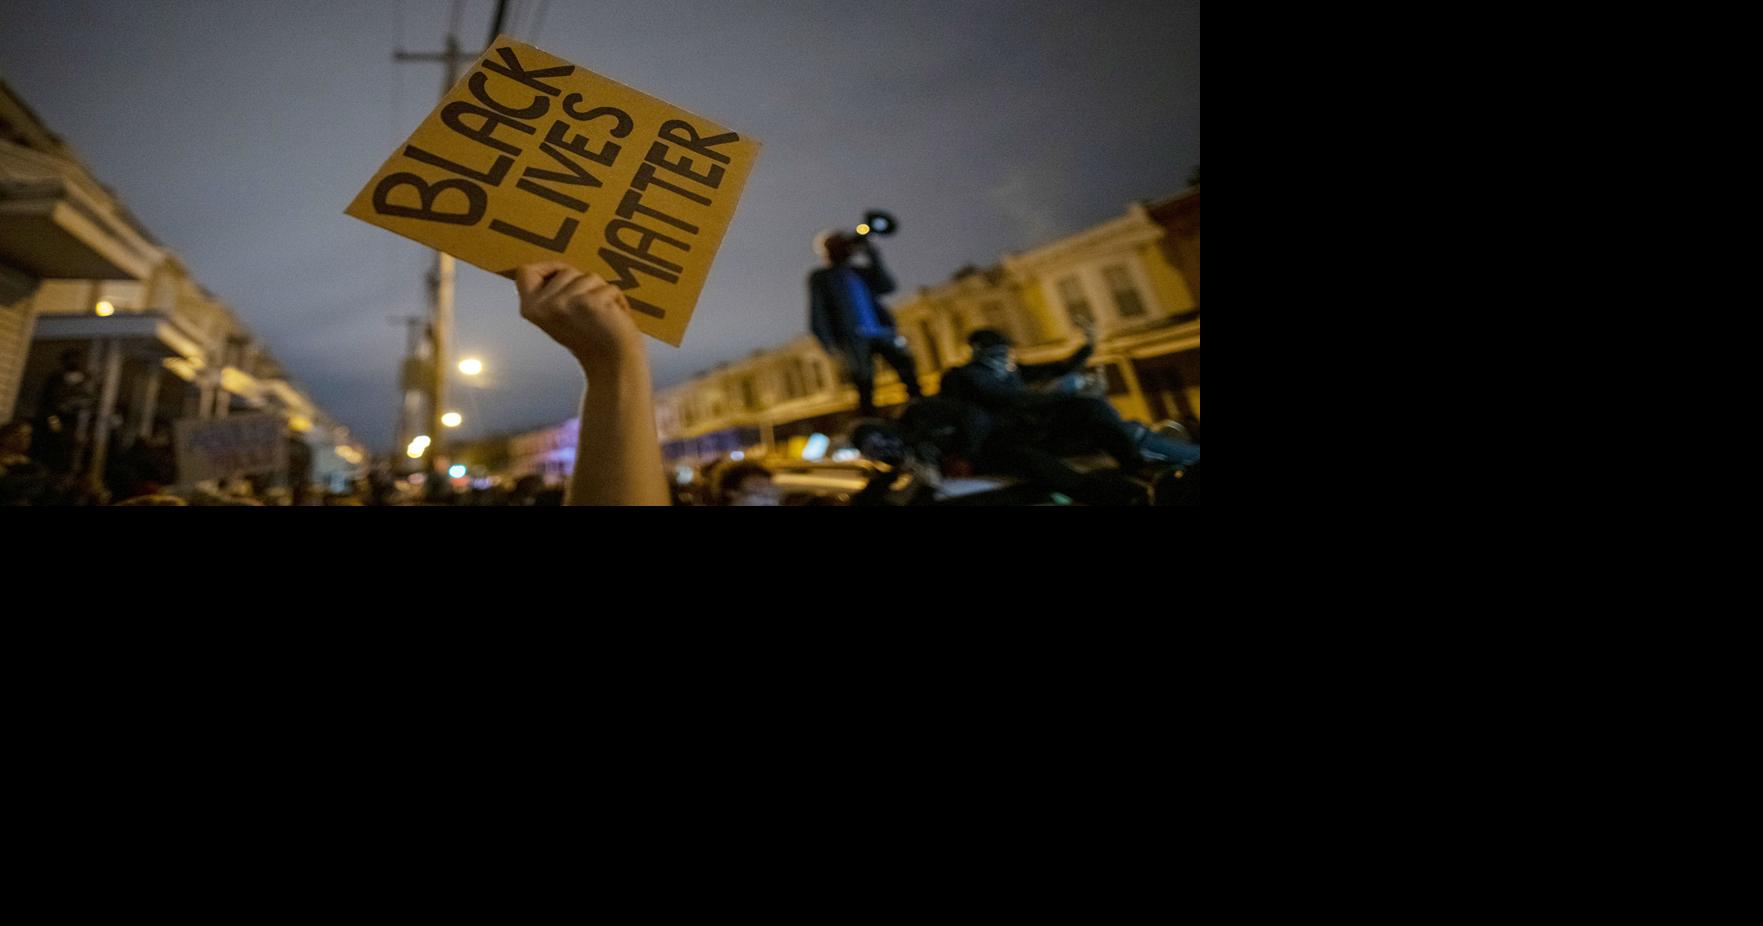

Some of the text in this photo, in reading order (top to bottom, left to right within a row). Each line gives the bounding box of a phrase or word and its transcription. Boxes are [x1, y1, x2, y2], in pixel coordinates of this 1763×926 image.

[372, 46, 575, 226] BLACK
[489, 92, 634, 253] LIVES
[597, 119, 740, 319] MATTER
